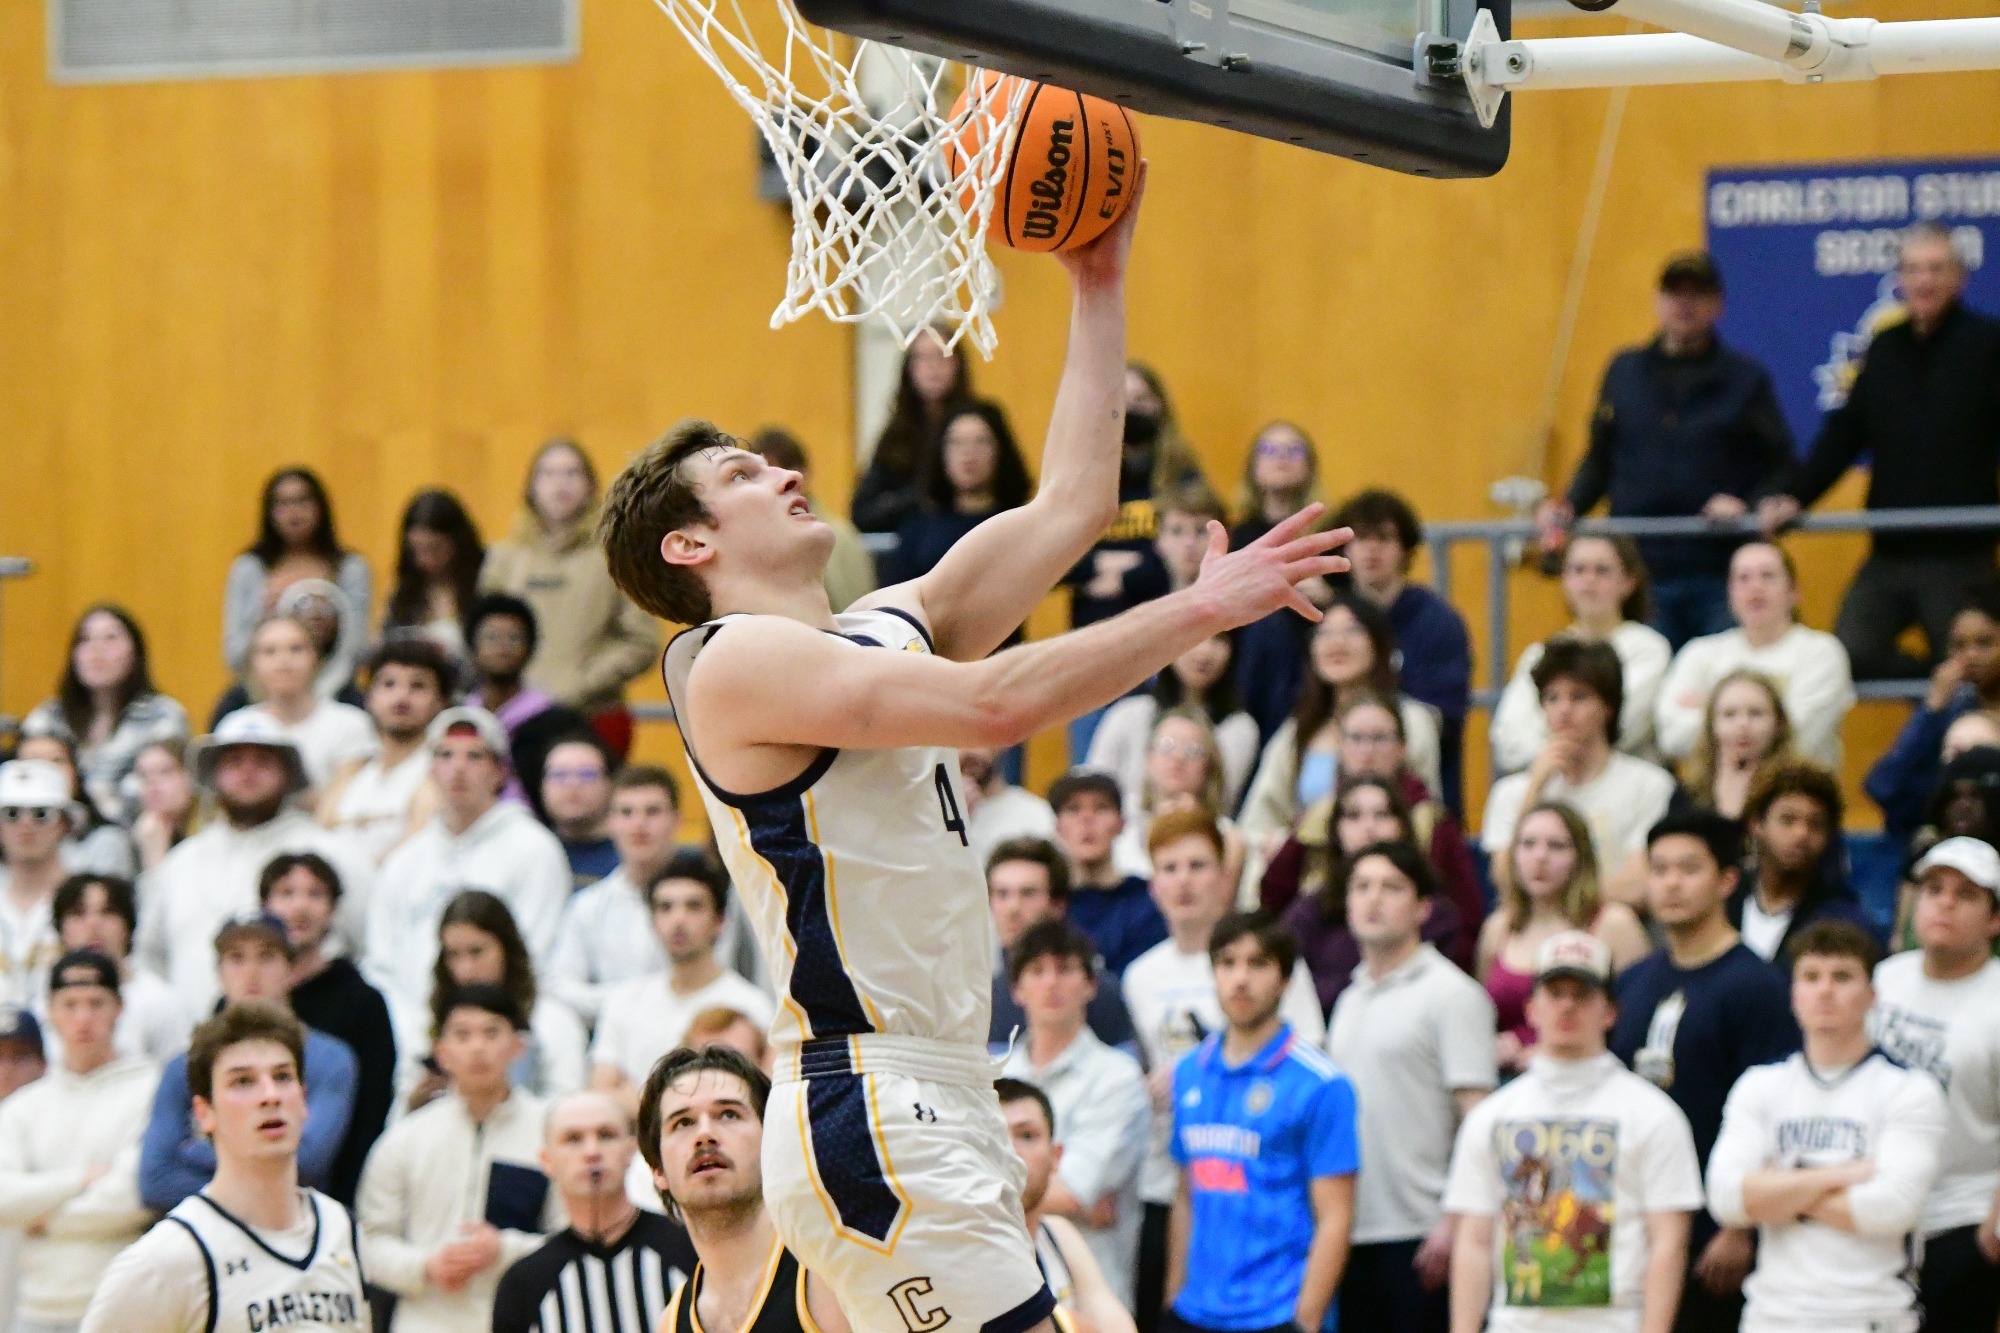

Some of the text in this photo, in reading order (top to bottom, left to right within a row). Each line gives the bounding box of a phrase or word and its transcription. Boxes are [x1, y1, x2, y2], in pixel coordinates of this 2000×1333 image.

[1022, 120, 1074, 238] Wilson
[1099, 147, 1125, 219] EVO
[1710, 176, 1909, 227] CARLETON
[935, 763, 968, 846] 4
[886, 1276, 951, 1333] C
